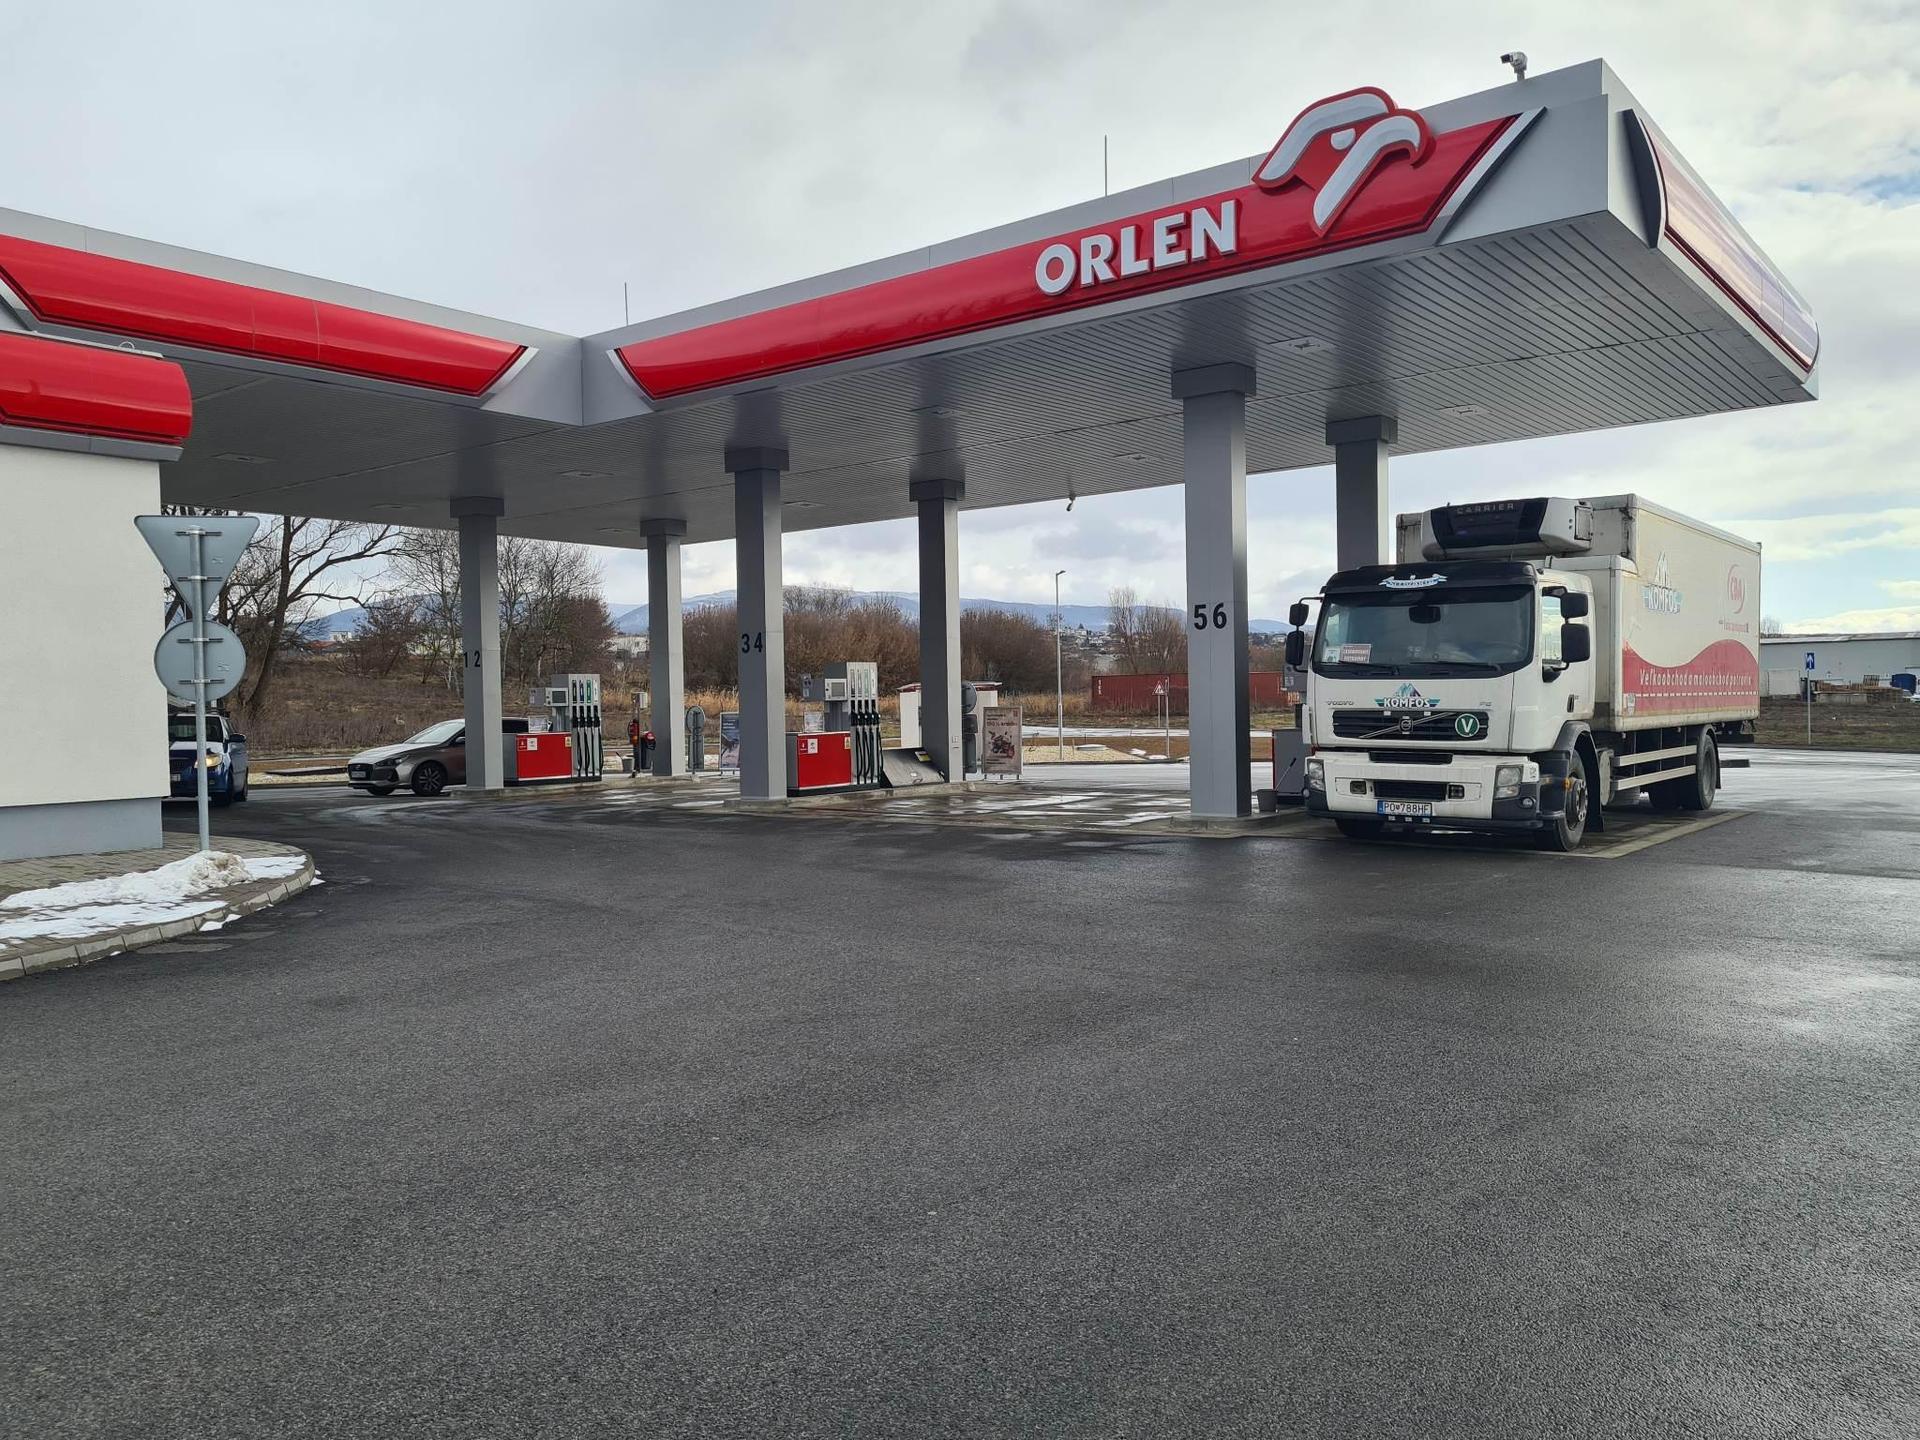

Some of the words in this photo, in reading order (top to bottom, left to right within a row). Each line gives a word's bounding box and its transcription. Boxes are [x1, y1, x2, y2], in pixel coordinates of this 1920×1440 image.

[1035, 199, 1237, 296] ORLEN
[1457, 503, 1514, 514] CARRIER
[1648, 586, 1680, 614] KOMFOS
[1383, 698, 1431, 708] KOMFOS
[1461, 718, 1475, 733] V
